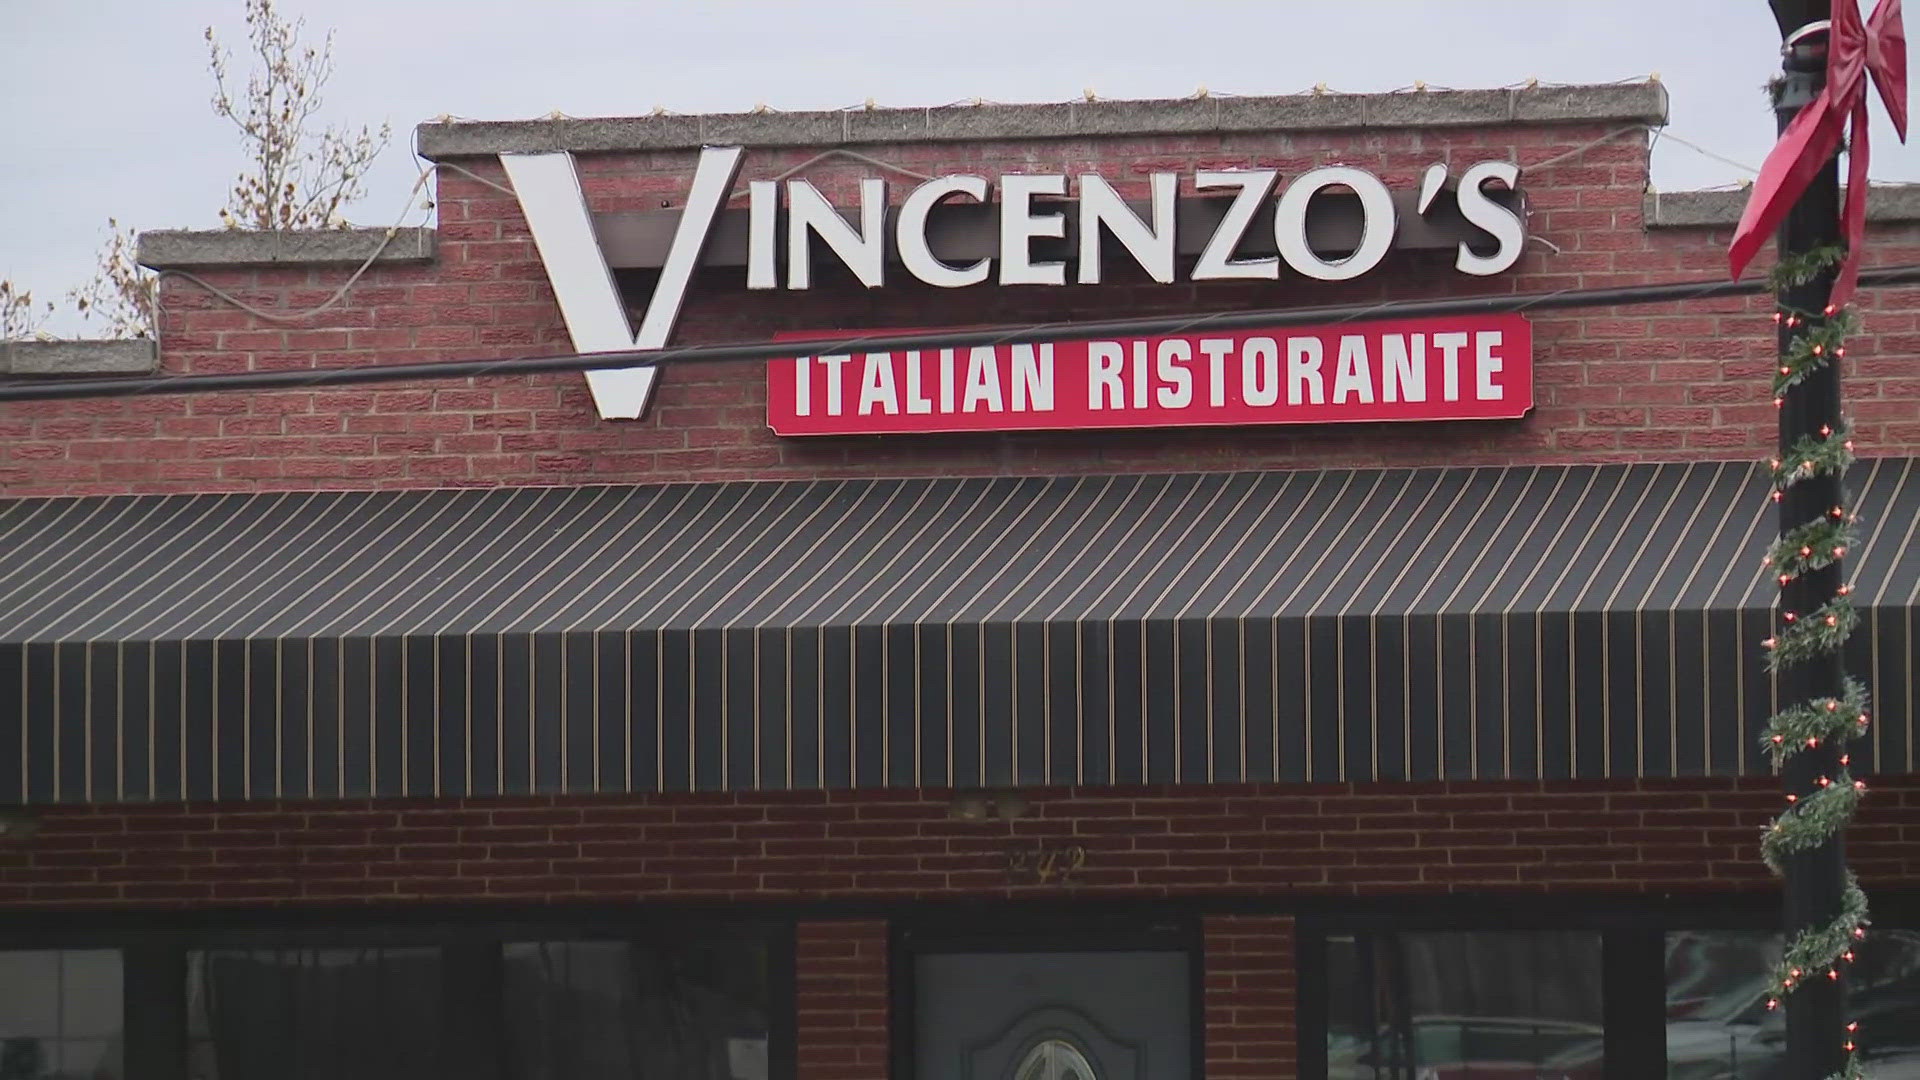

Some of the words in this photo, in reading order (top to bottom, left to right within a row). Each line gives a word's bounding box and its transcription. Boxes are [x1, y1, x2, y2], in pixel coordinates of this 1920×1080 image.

[499, 145, 1525, 420] VINCENZO'S
[795, 343, 1054, 416] ITALIAN
[1088, 331, 1503, 411] RISTORANTE
